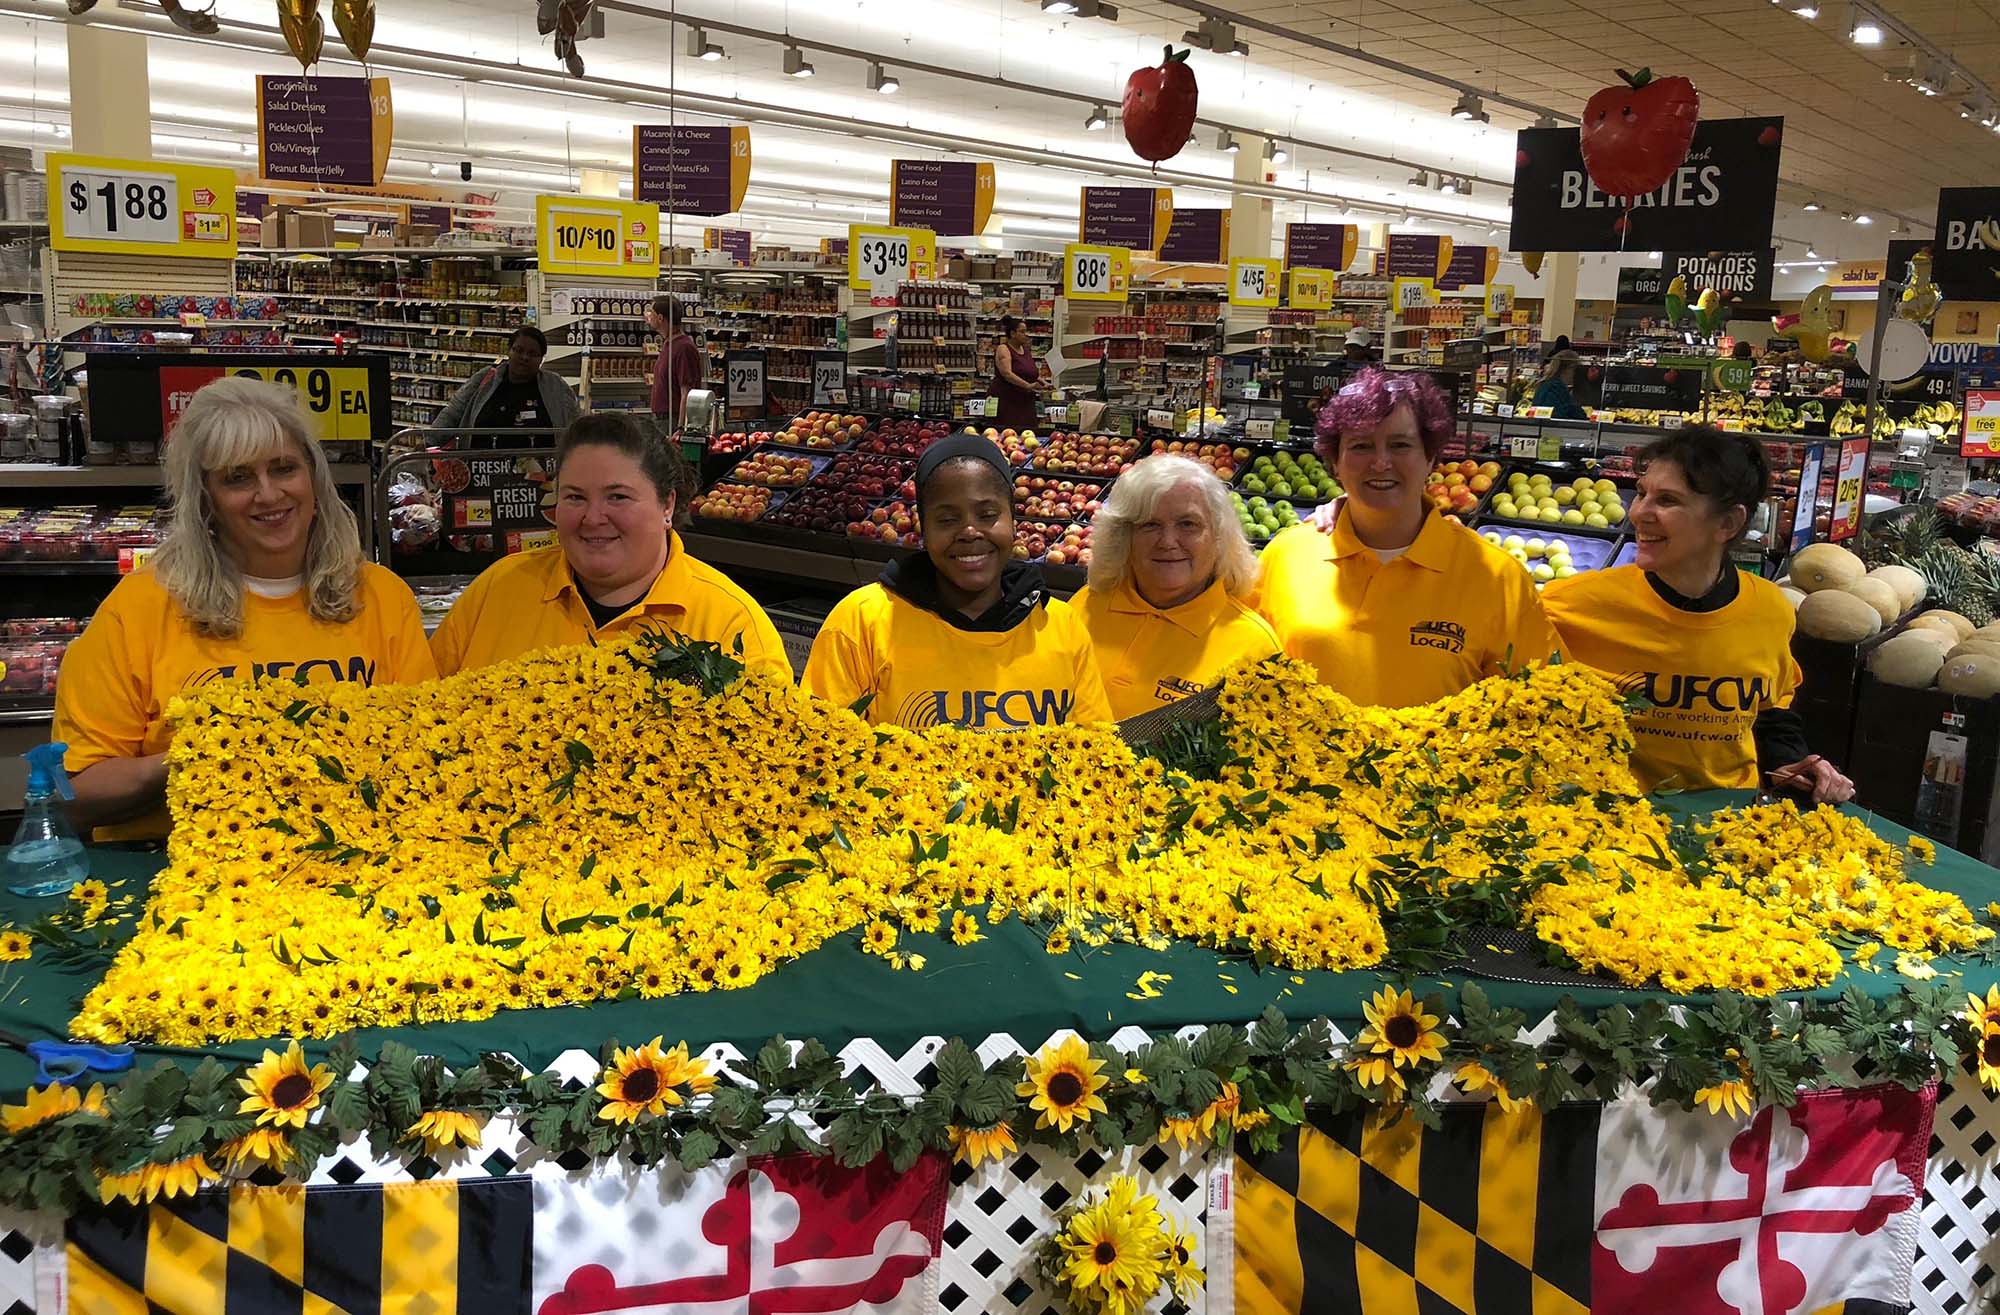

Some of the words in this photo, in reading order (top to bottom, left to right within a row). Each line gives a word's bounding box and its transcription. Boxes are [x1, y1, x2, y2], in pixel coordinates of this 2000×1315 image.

[267, 101, 289, 111] Salad
[291, 102, 327, 114] Dressing
[373, 95, 388, 115] 13
[268, 122, 324, 134] Pickles/Olives
[685, 130, 711, 139] Cheese
[269, 143, 320, 156] Oils/Vinegar
[643, 146, 670, 154] Canned
[671, 147, 690, 156] Soup
[733, 141, 747, 157] 12
[270, 163, 298, 174] Peanut
[300, 164, 345, 177] Butter/Jelly
[643, 163, 669, 172] Canned
[900, 163, 924, 171] Chinese
[643, 181, 665, 190] Baked
[901, 178, 920, 186] Latino
[979, 175, 992, 189] 11
[671, 200, 700, 208] Seafood
[899, 207, 924, 215] Mexican
[1159, 199, 1170, 211] 10
[557, 225, 615, 250] 10/$10
[1947, 220, 2000, 250] BA
[863, 242, 908, 275] $349
[1677, 257, 1757, 275] POTATOES
[1077, 258, 1106, 288] 88¢
[1842, 270, 1862, 282] salad
[1864, 269, 1878, 281] bar
[1242, 269, 1265, 295] 4/$5
[1693, 275, 1754, 291] ONIONS
[730, 368, 758, 392] $299
[816, 368, 840, 391] $299
[1728, 368, 1743, 384] 59
[1926, 379, 1944, 394] 49
[341, 391, 368, 414] EA
[1976, 419, 1995, 429] free
[1513, 438, 1536, 450] $159
[471, 461, 508, 474] FRESH
[494, 488, 537, 504] FRESH
[496, 503, 536, 519] FRUIT
[1410, 633, 1450, 650] Local
[1643, 671, 1772, 712] UFCW
[931, 689, 1075, 727] UFCW
[1652, 709, 1672, 719] for
[1676, 711, 1729, 725] working
